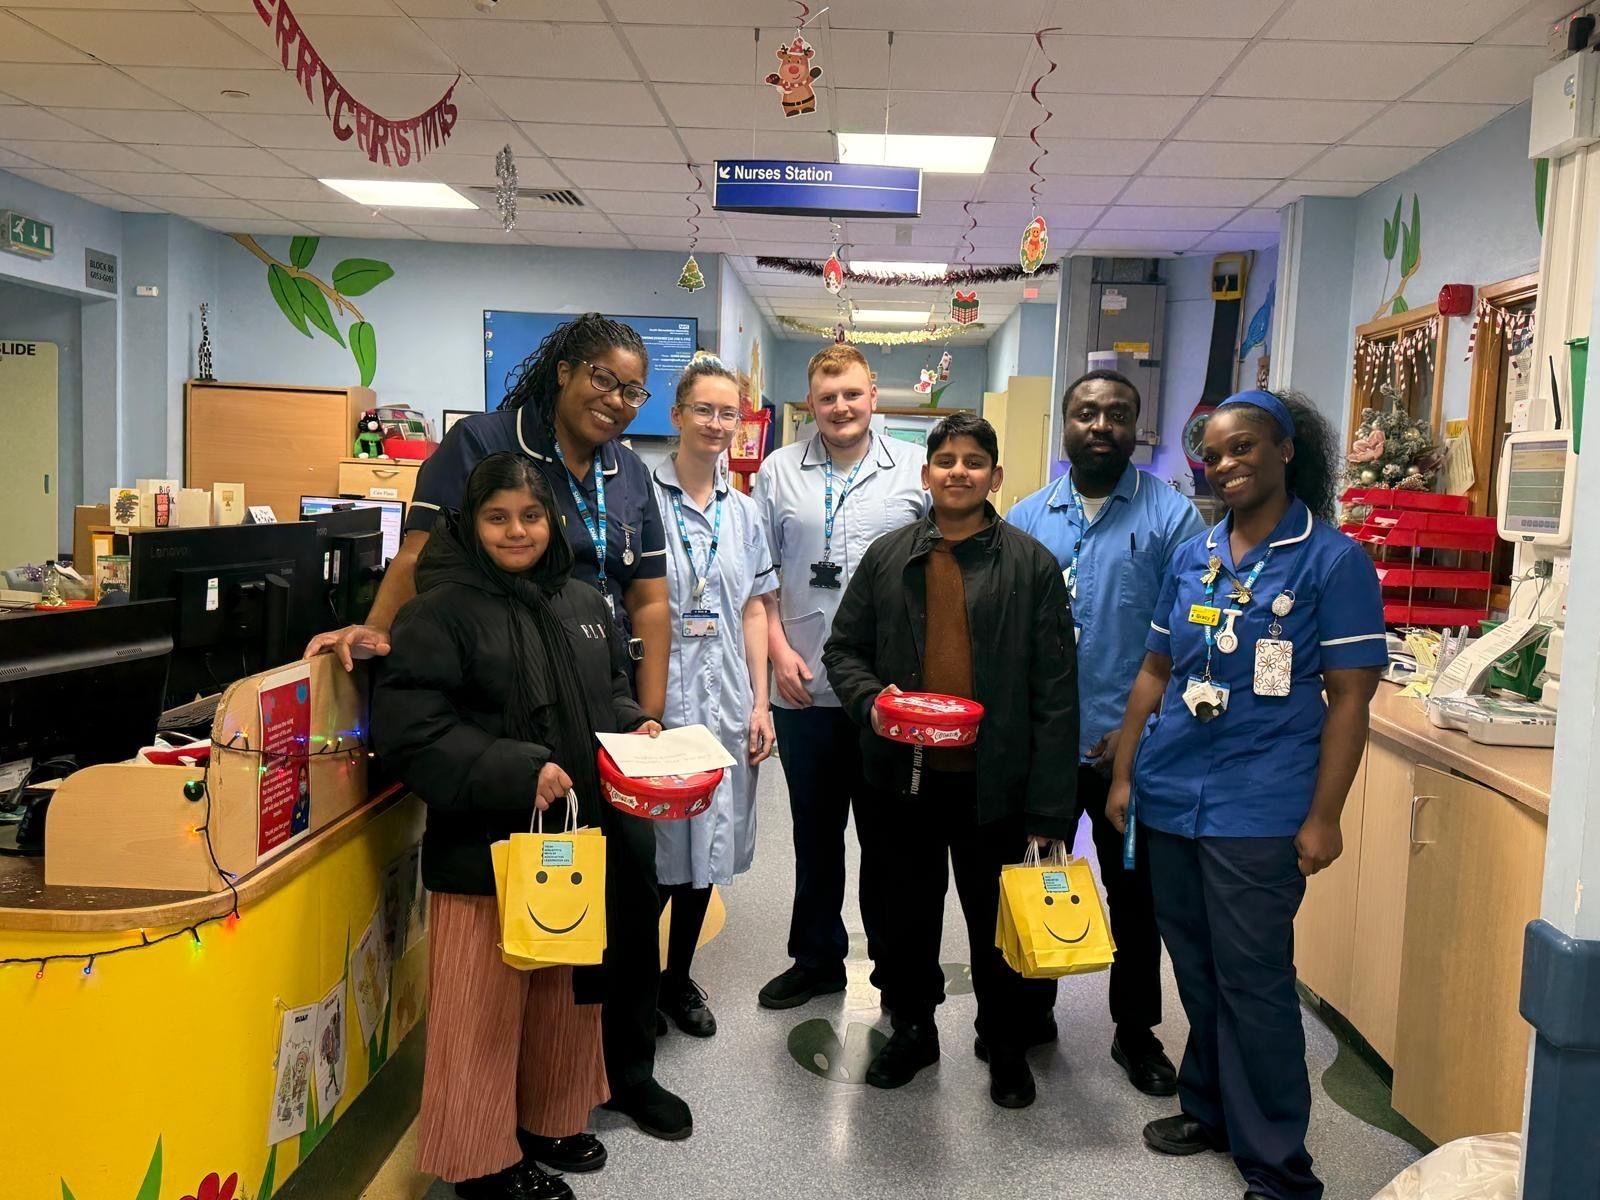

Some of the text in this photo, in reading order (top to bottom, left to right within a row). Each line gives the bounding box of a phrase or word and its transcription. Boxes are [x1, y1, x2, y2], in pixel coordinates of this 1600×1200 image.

[333, 88, 457, 167] CHRISTMAS
[734, 166, 832, 182] Nurses Station
[90, 260, 108, 272] BLOCK
[151, 546, 189, 558] Lenovo
[911, 768, 920, 794] TOMMY
